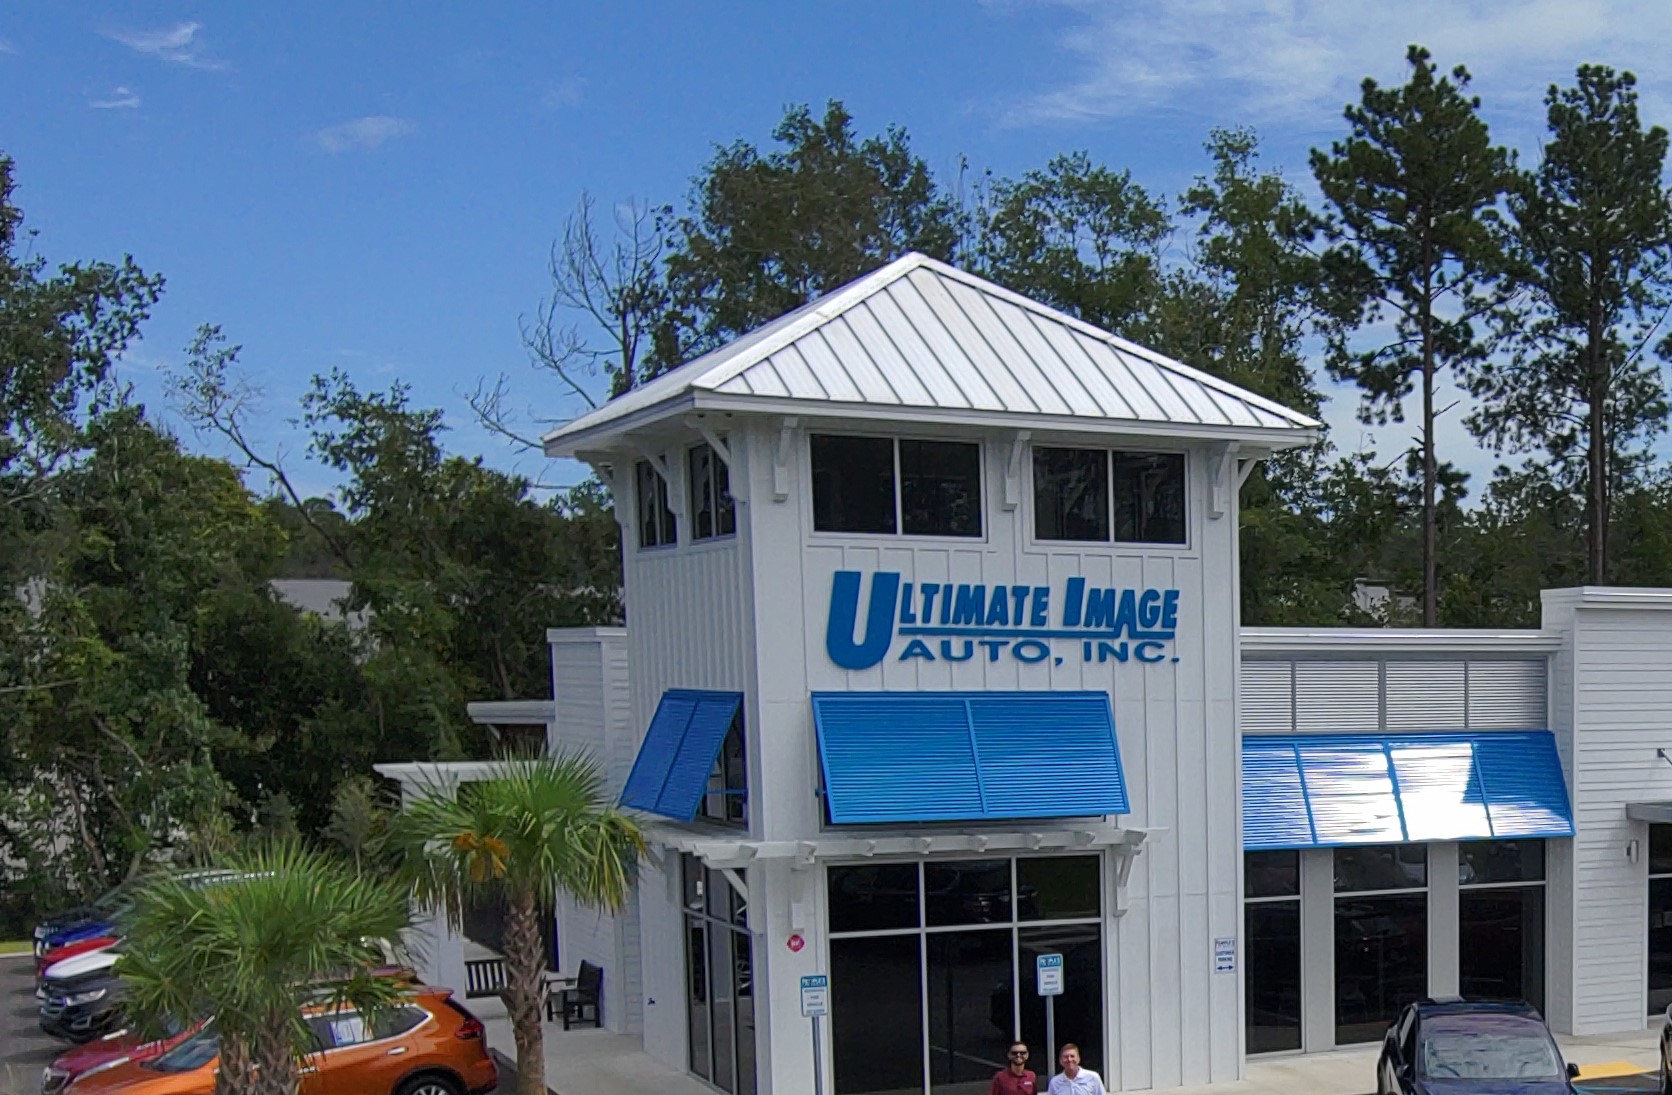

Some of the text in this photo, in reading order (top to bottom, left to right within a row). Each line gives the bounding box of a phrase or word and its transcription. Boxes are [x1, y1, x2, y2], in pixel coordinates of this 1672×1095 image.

[826, 571, 1180, 671] ULTIMATE IMAGE
[898, 640, 1180, 666] AUTO, INC.
